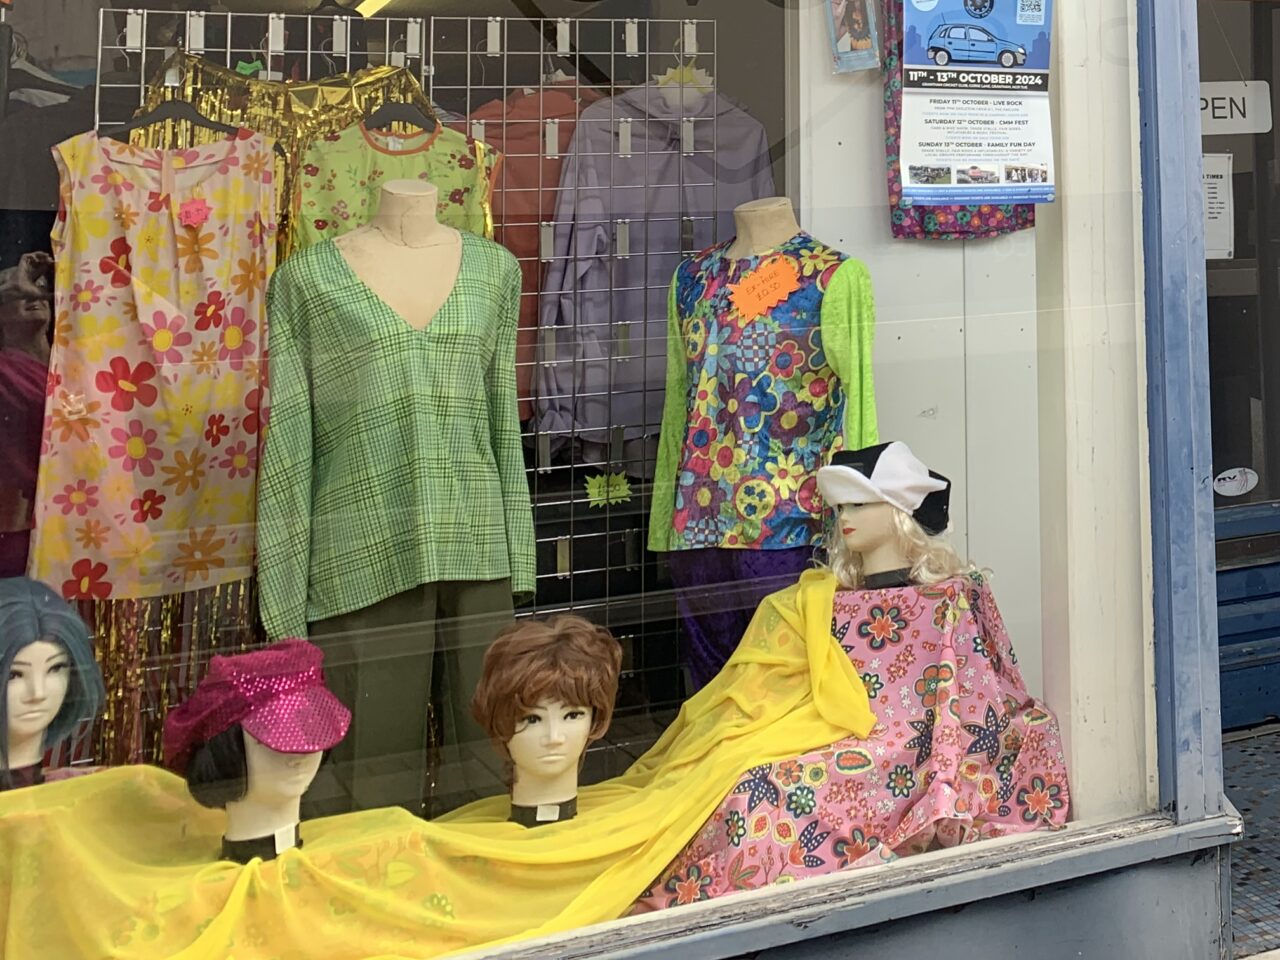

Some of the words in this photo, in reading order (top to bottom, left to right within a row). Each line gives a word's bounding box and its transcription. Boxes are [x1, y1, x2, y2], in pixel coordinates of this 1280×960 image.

[959, 72, 1013, 84] OCTOBER
[1015, 74, 1043, 85] 2024
[1200, 96, 1247, 119] PEN
